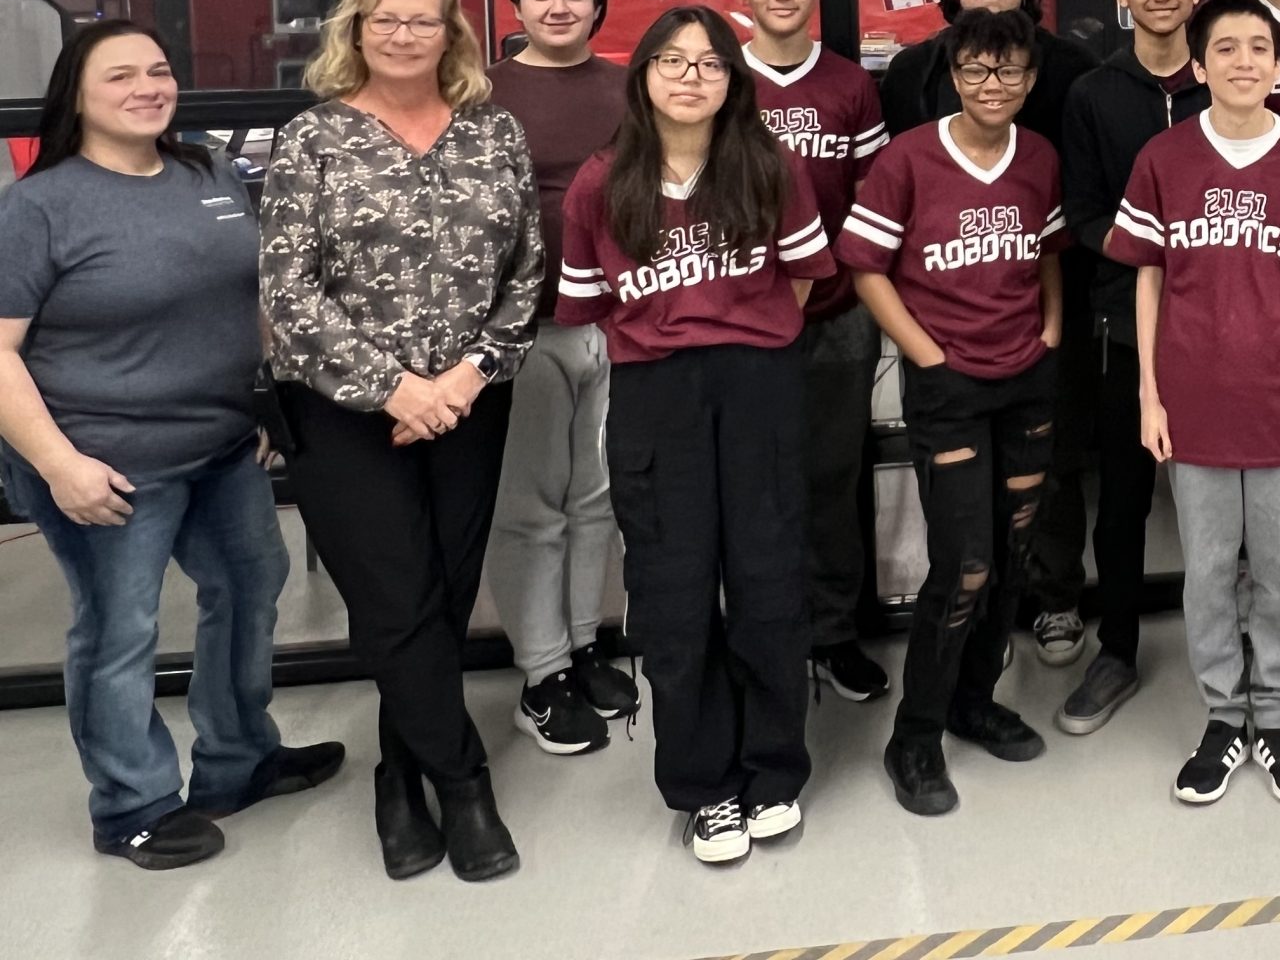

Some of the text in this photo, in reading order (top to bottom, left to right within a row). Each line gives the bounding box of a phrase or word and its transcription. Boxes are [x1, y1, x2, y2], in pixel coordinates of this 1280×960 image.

[760, 107, 821, 134] 2151
[1205, 187, 1267, 221] 2151
[959, 206, 1023, 239] 2151
[618, 246, 767, 303] ROBOTICS
